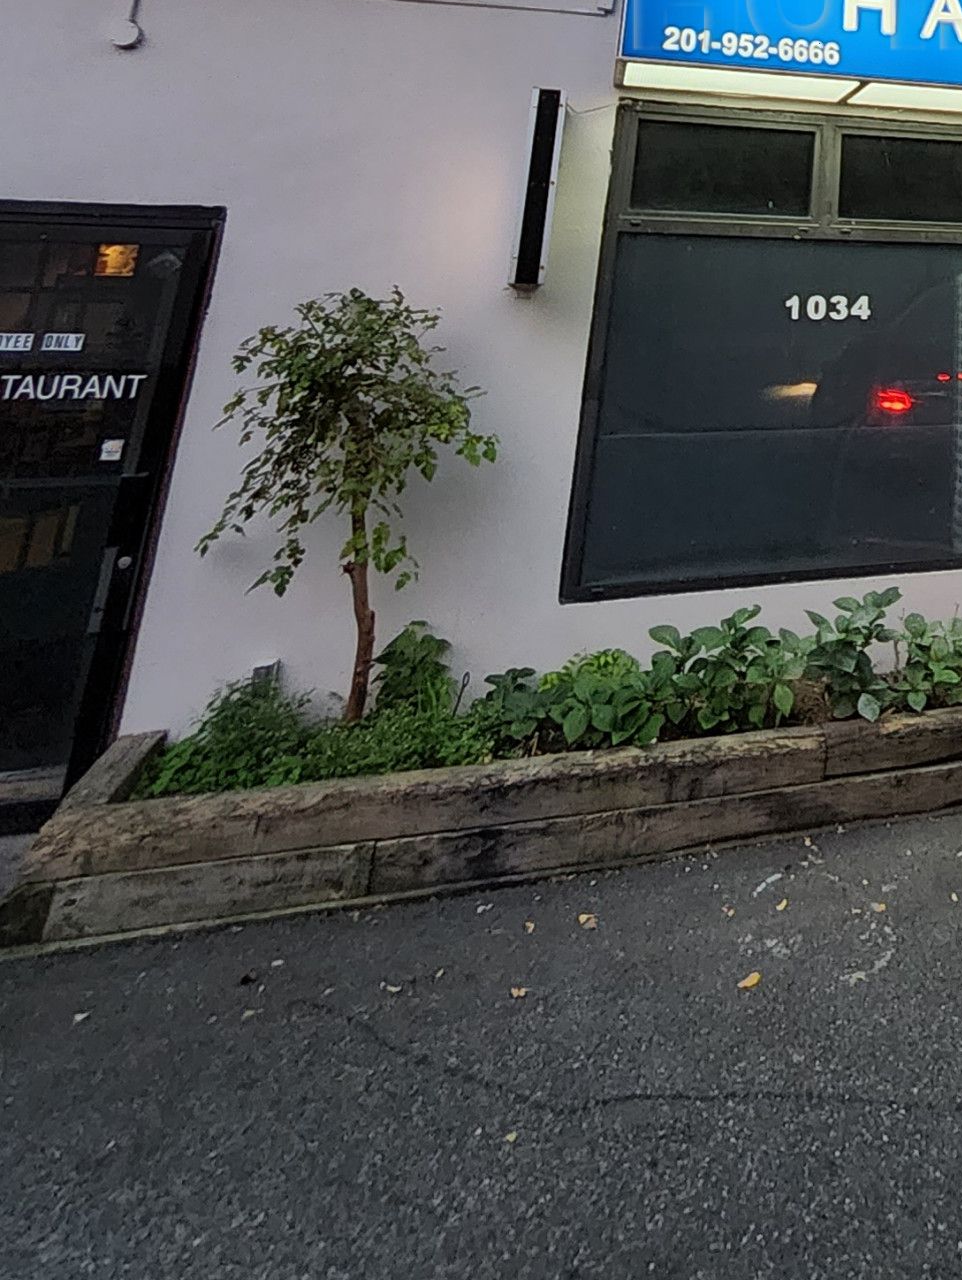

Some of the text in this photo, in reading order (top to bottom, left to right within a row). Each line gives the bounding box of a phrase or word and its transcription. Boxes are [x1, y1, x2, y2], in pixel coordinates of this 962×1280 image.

[662, 25, 841, 66] 201-952-6666
[785, 295, 871, 320] 1034
[45, 335, 82, 348] ONLY
[0, 374, 148, 400] TAURANT
